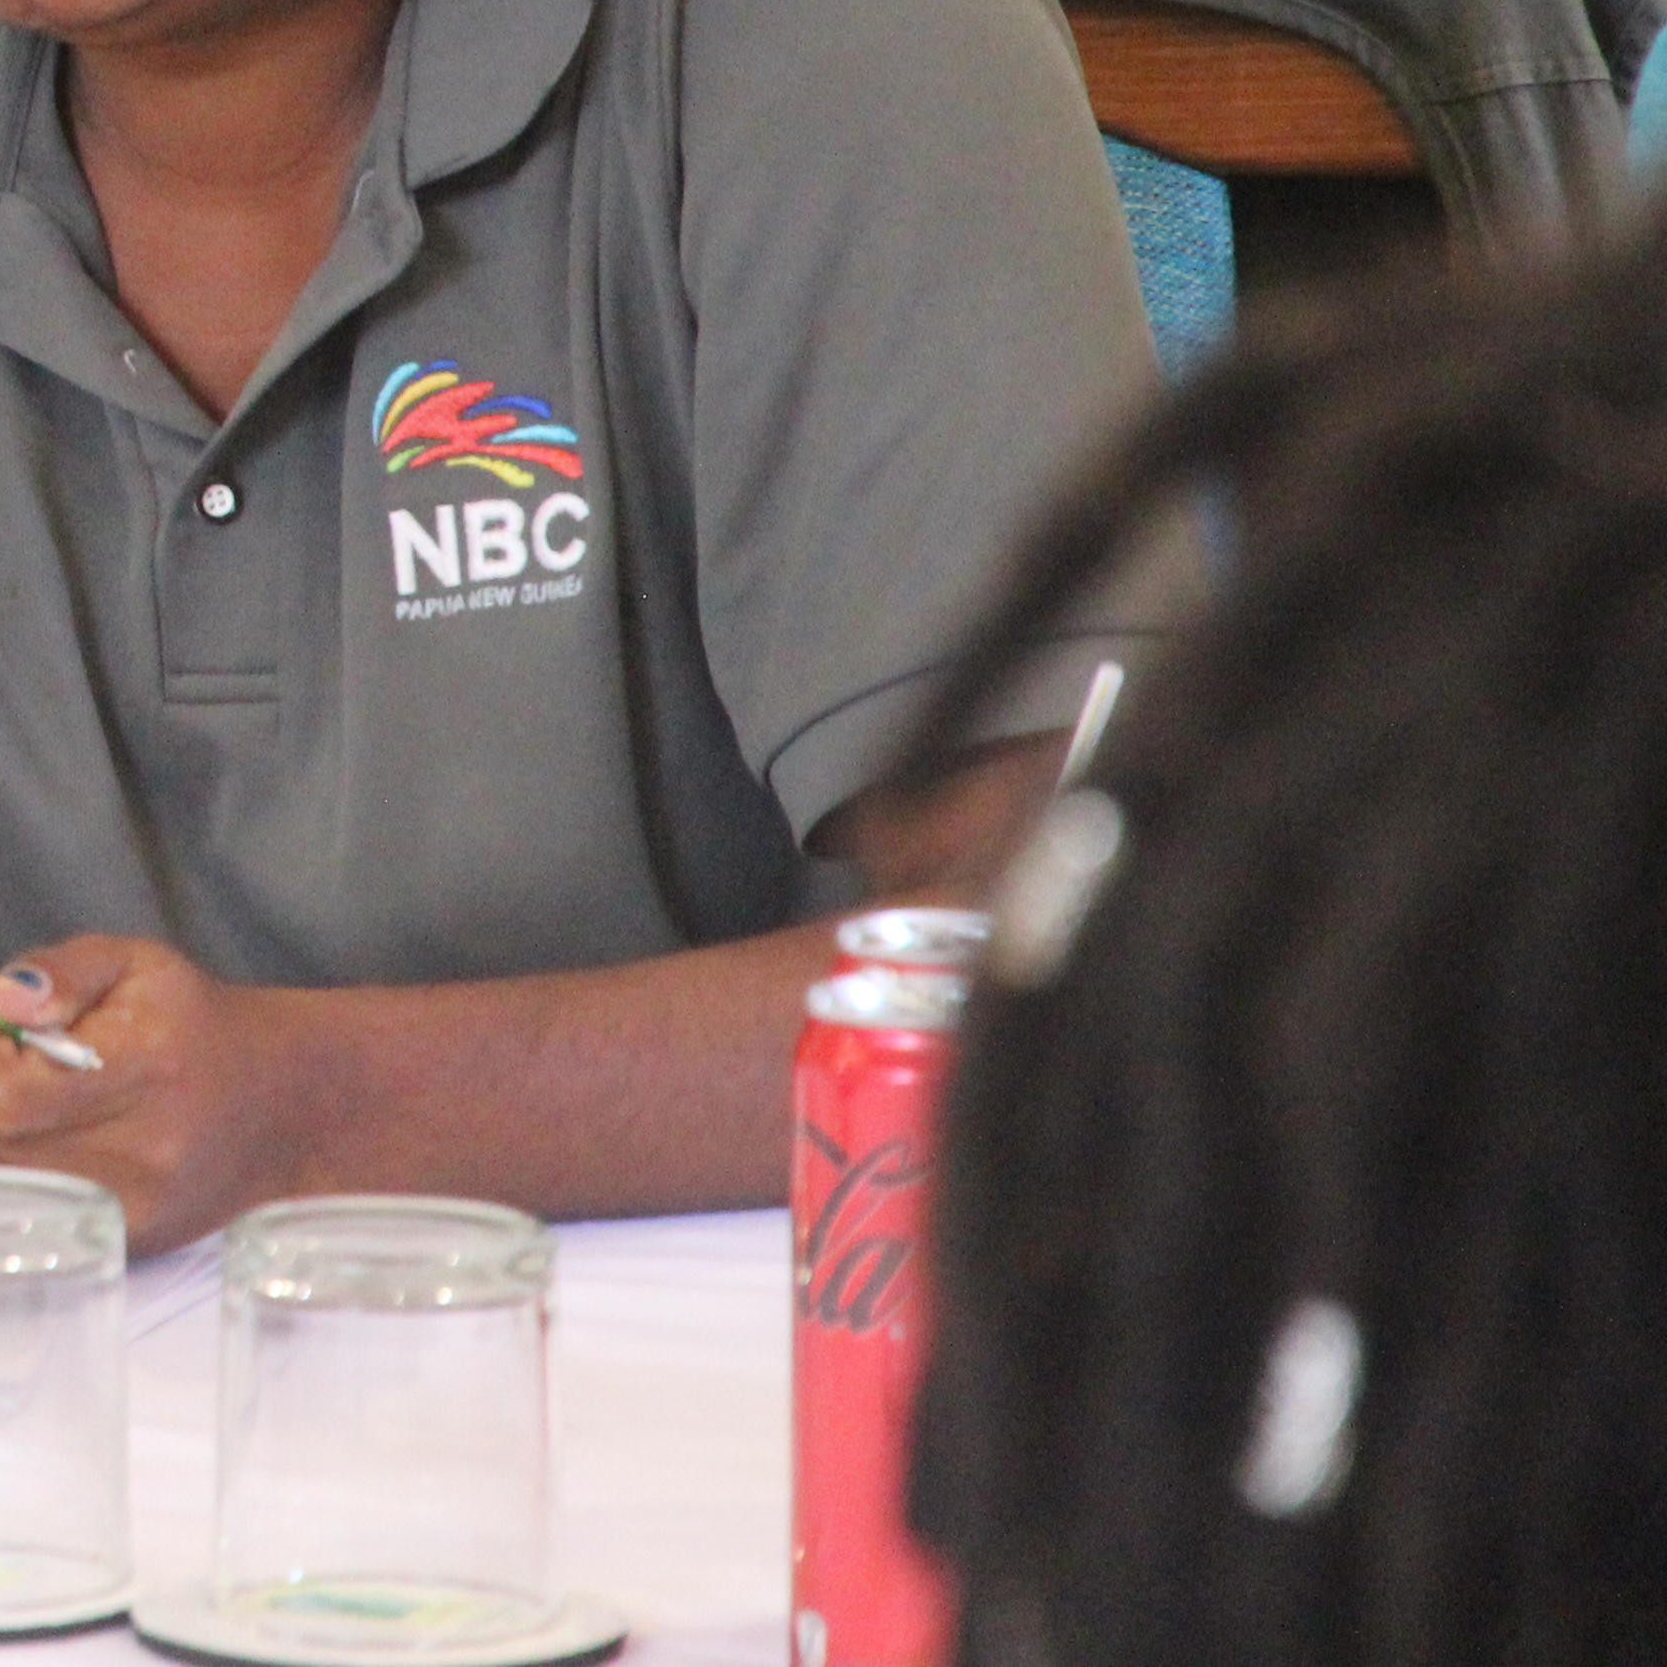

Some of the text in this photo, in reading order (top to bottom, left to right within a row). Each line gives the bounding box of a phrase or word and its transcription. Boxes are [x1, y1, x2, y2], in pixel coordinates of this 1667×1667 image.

[389, 492, 590, 596] NBC
[395, 594, 465, 621] PAPUA
[468, 586, 516, 610] NEW
